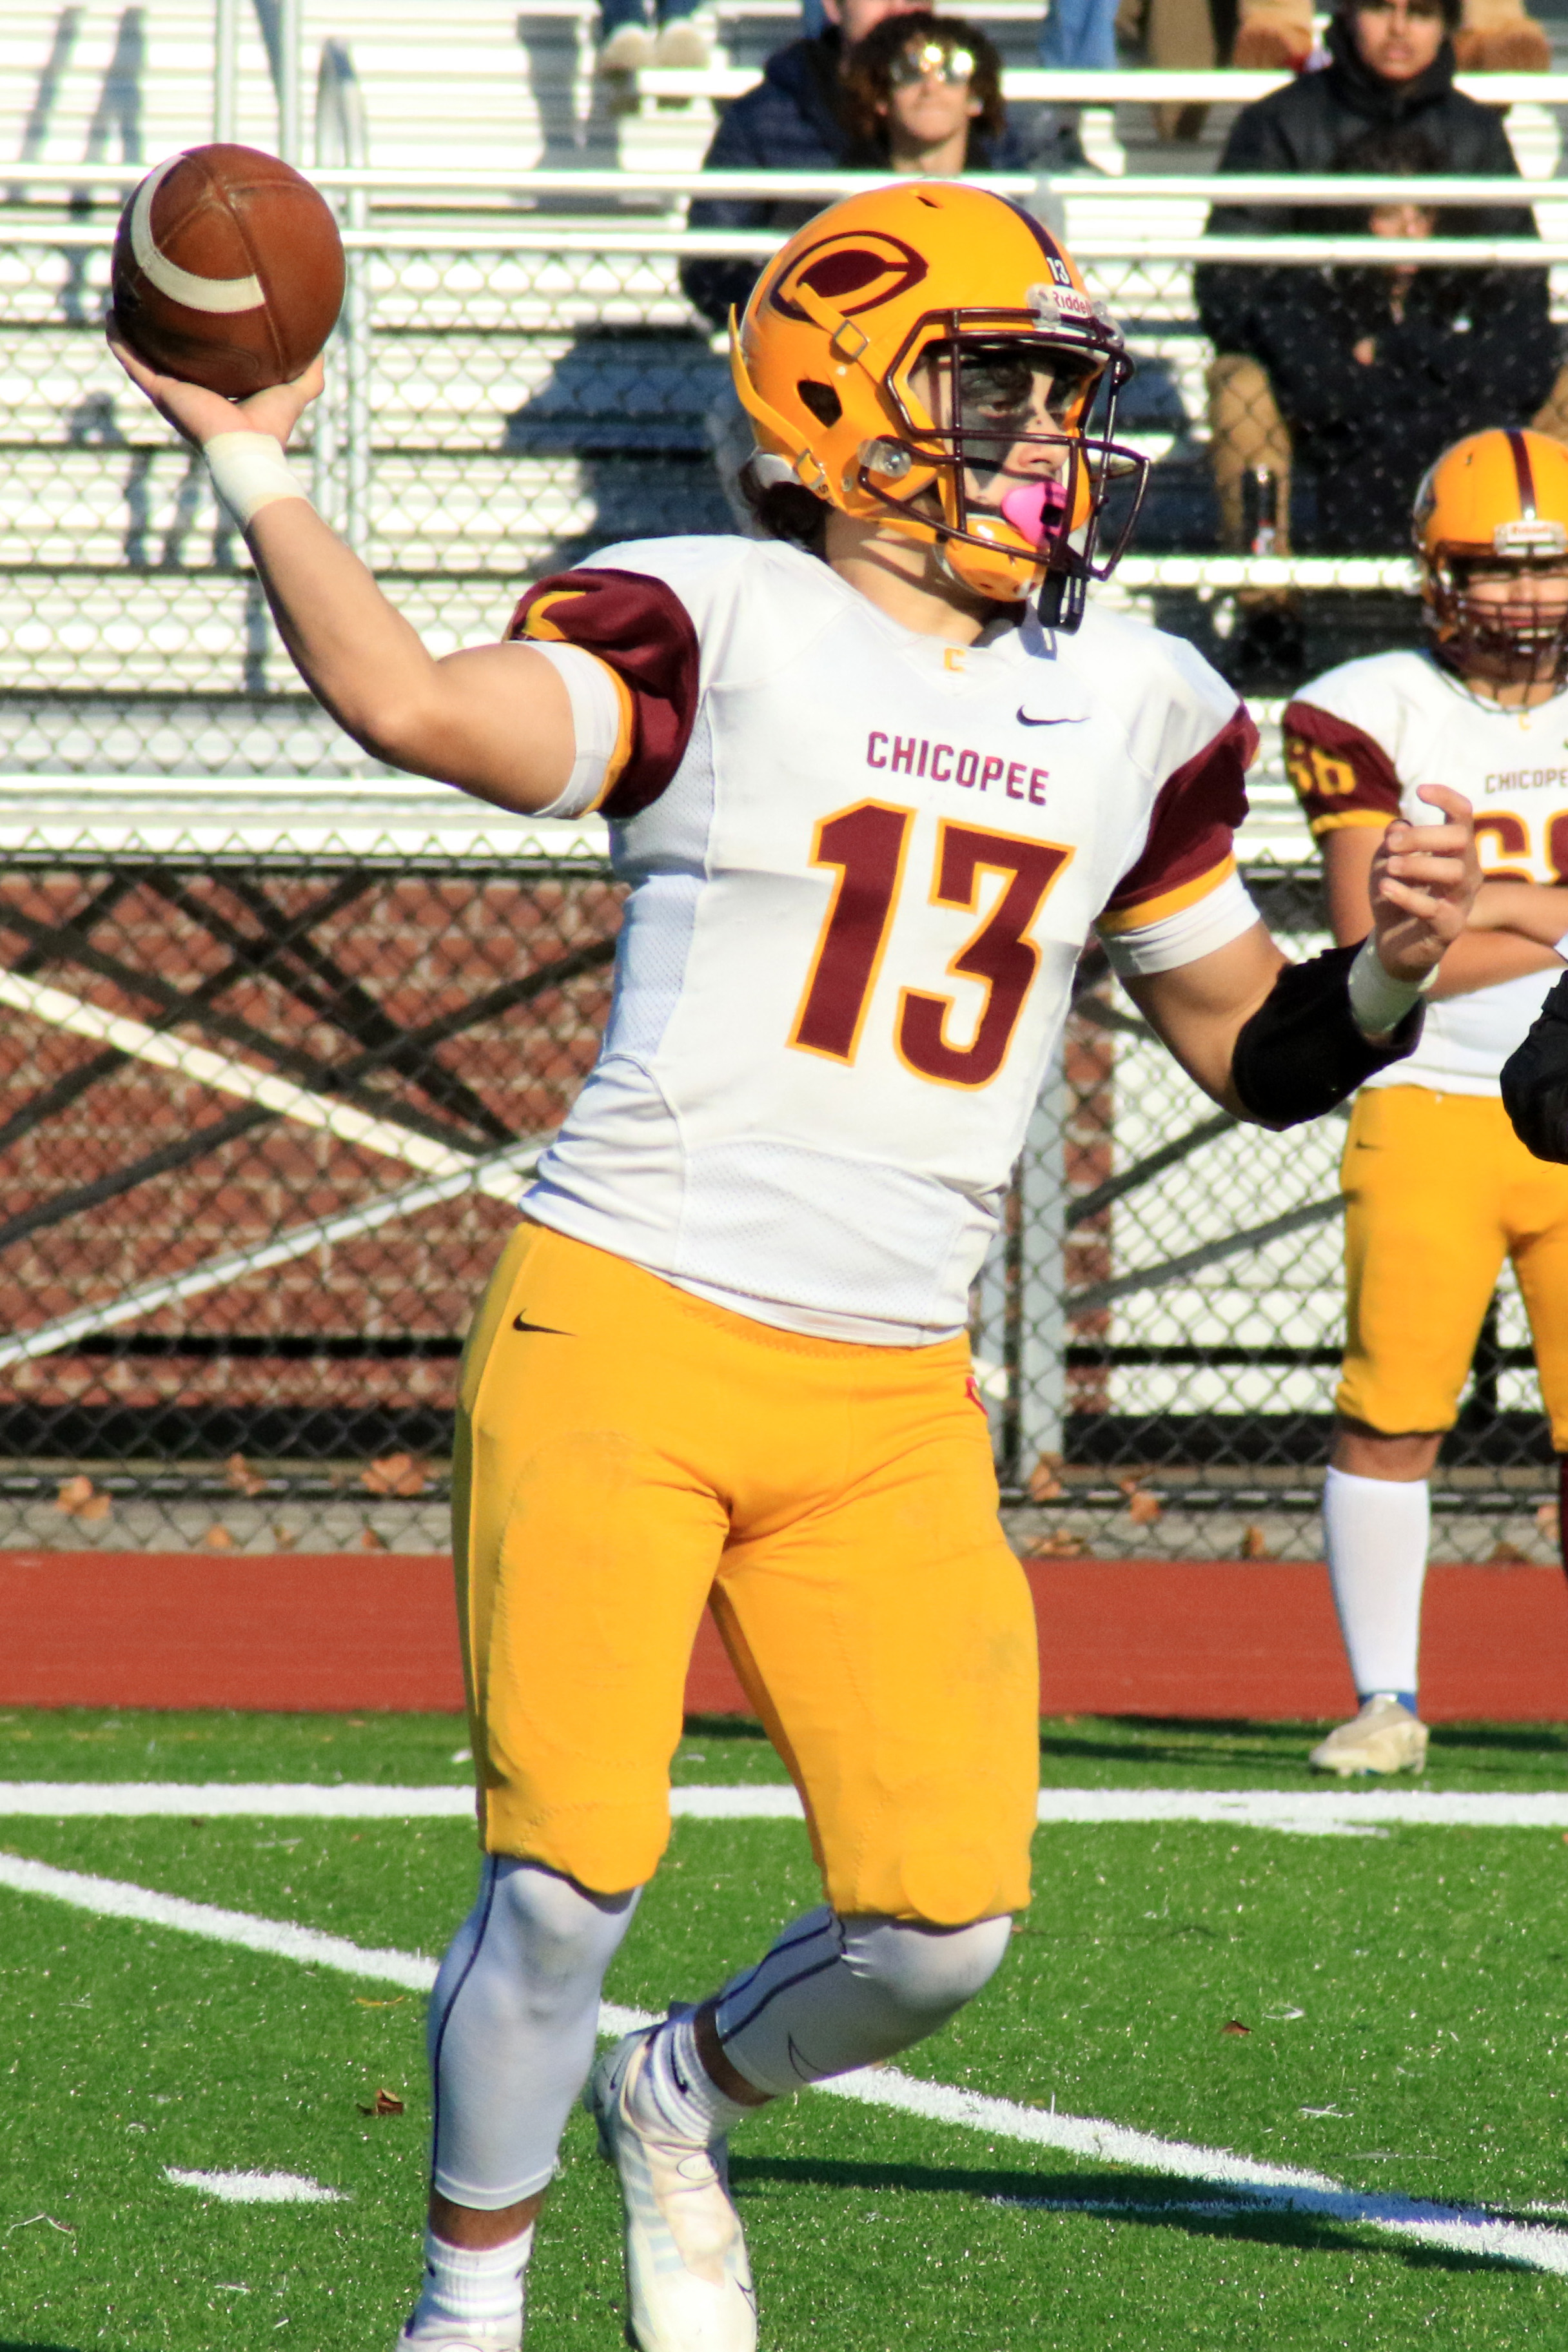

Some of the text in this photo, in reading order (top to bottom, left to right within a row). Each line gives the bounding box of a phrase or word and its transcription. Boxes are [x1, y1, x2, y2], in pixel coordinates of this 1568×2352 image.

[1046, 257, 1071, 284] 13
[944, 647, 966, 672] C
[867, 731, 1049, 806] CHICOPEE
[784, 797, 1077, 1092] 13
